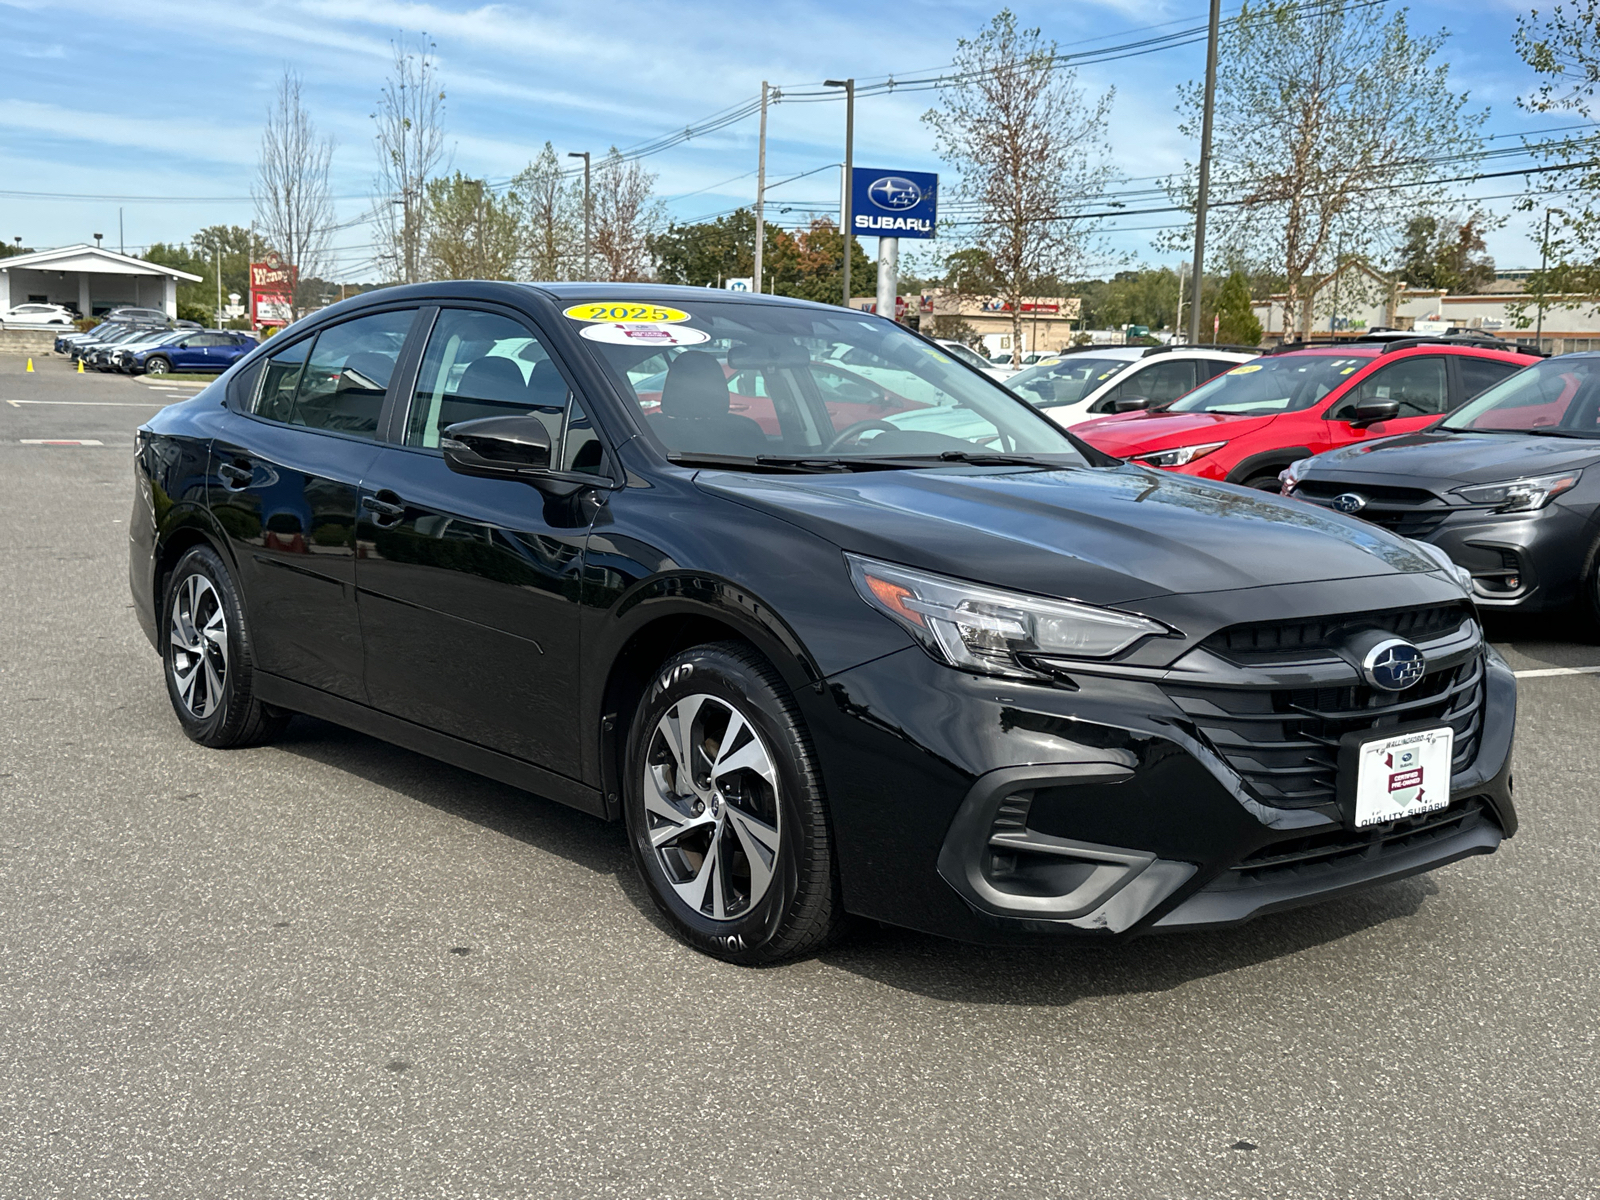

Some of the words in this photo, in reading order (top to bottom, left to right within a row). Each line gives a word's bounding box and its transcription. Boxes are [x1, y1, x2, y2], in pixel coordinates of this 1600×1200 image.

[855, 214, 931, 232] SUBARU
[589, 306, 670, 321] 2025
[651, 663, 694, 704] AVID
[1361, 811, 1404, 827] QUALITY
[1407, 801, 1447, 817] SUBARU
